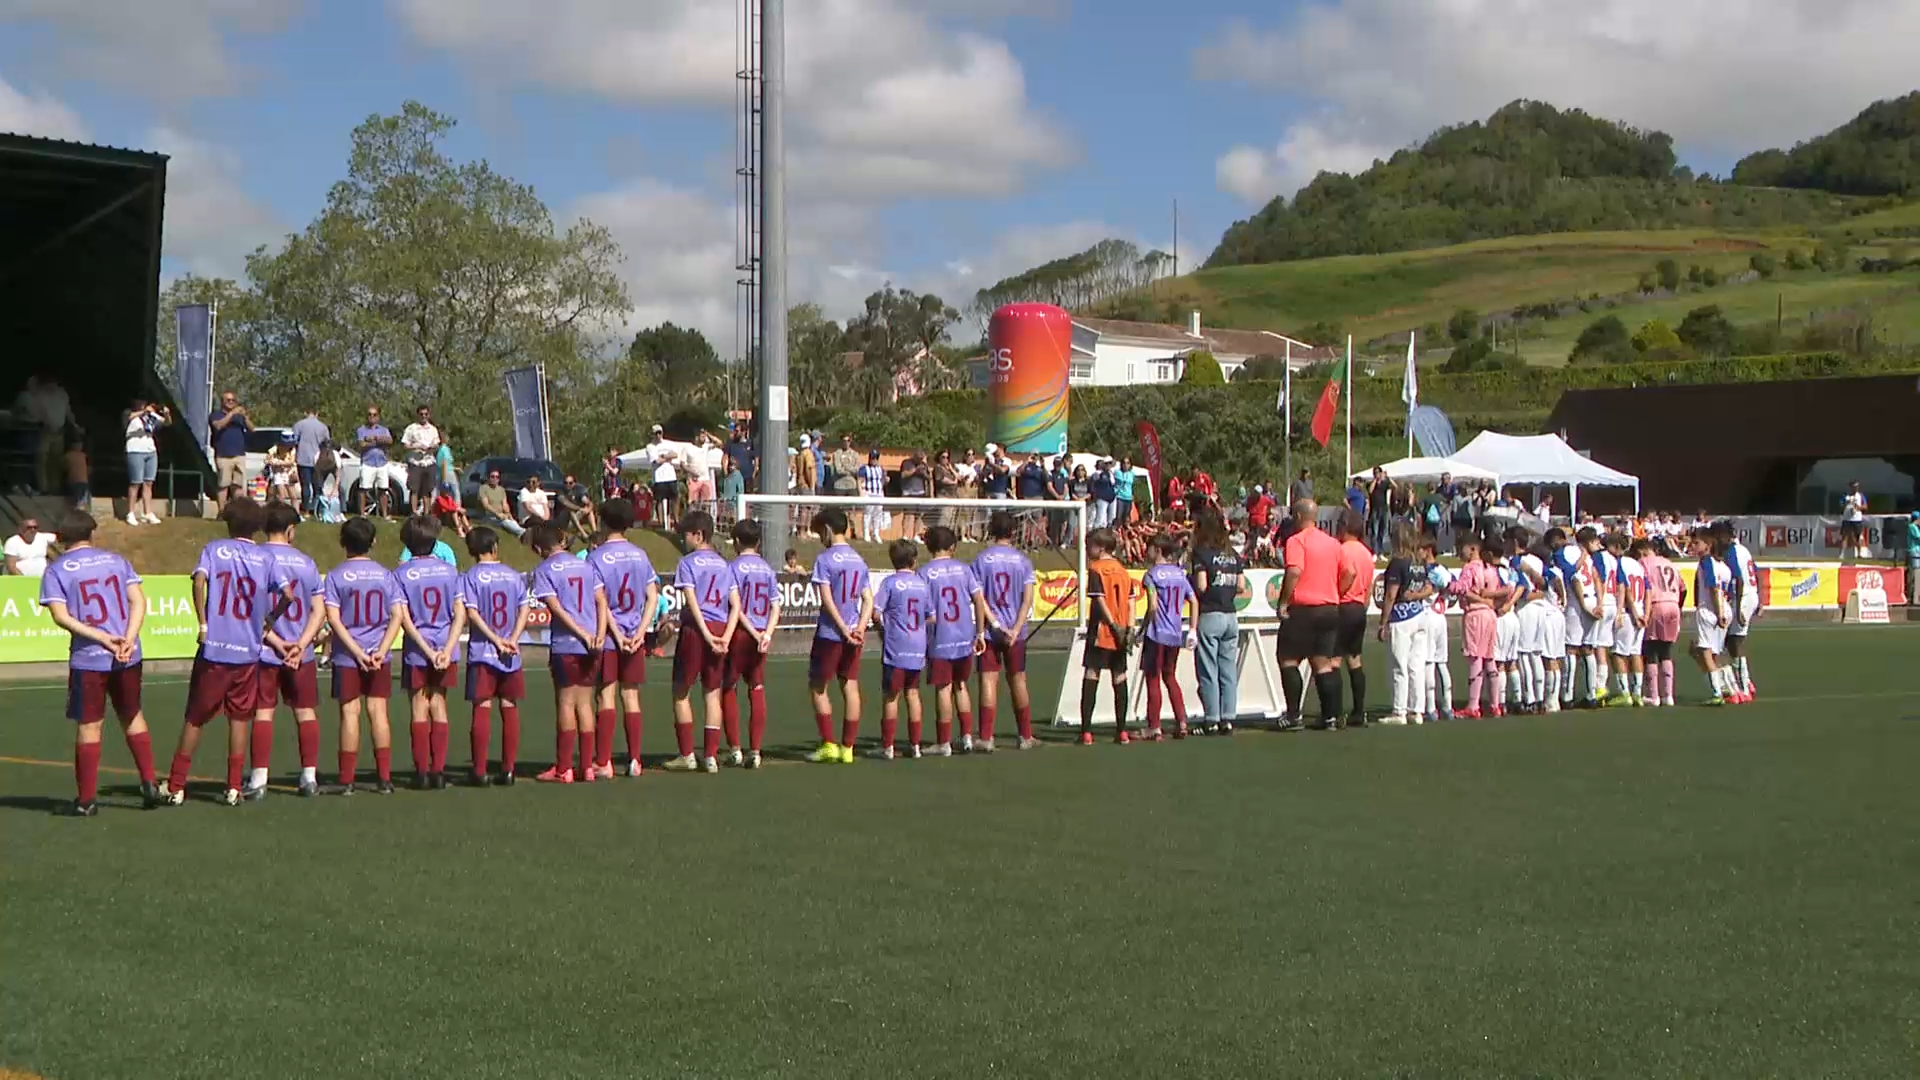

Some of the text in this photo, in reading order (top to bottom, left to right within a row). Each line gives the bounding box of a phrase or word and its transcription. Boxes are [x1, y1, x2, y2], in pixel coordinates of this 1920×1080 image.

[1787, 528, 1813, 545] BPI
[216, 570, 257, 621] 18
[568, 575, 584, 614] 7
[617, 572, 635, 612] 6
[705, 574, 722, 608] 4
[1656, 565, 1677, 593] 12
[1, 597, 20, 618] A
[79, 574, 127, 627] 51
[146, 597, 192, 617] LHA
[349, 588, 384, 627] 10
[423, 587, 442, 625] 9
[491, 590, 508, 630] 8
[742, 580, 770, 617] 15
[906, 598, 920, 632] 5
[941, 586, 961, 623] 3
